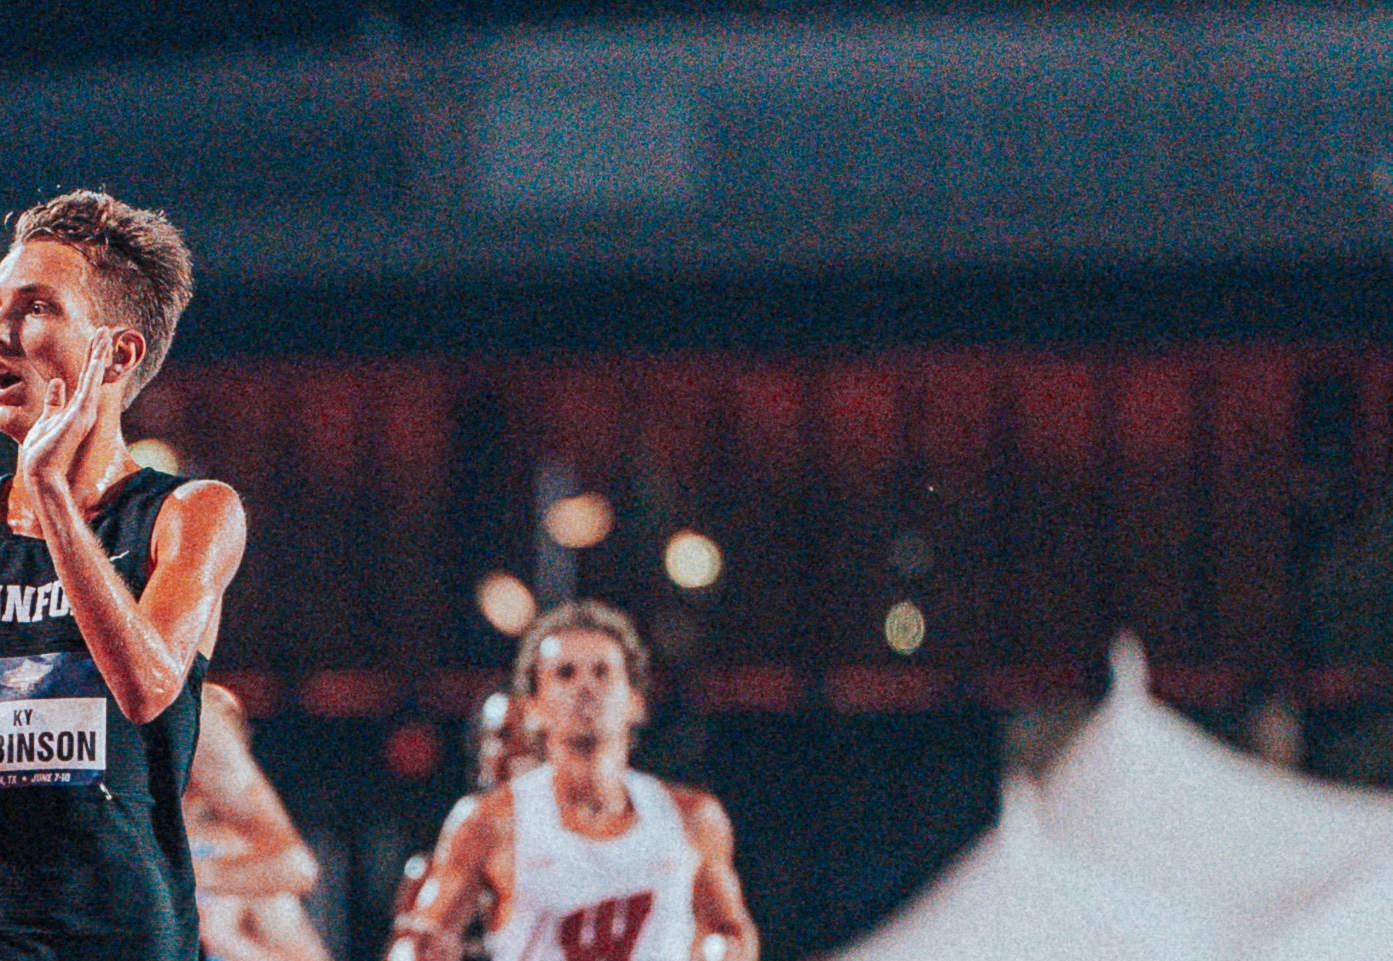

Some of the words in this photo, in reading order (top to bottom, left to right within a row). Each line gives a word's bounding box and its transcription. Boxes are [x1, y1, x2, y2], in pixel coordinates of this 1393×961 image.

[13, 709, 33, 726] KY
[7, 776, 17, 784] TX
[31, 773, 53, 783] JUNE
[54, 773, 71, 782] 7-10
